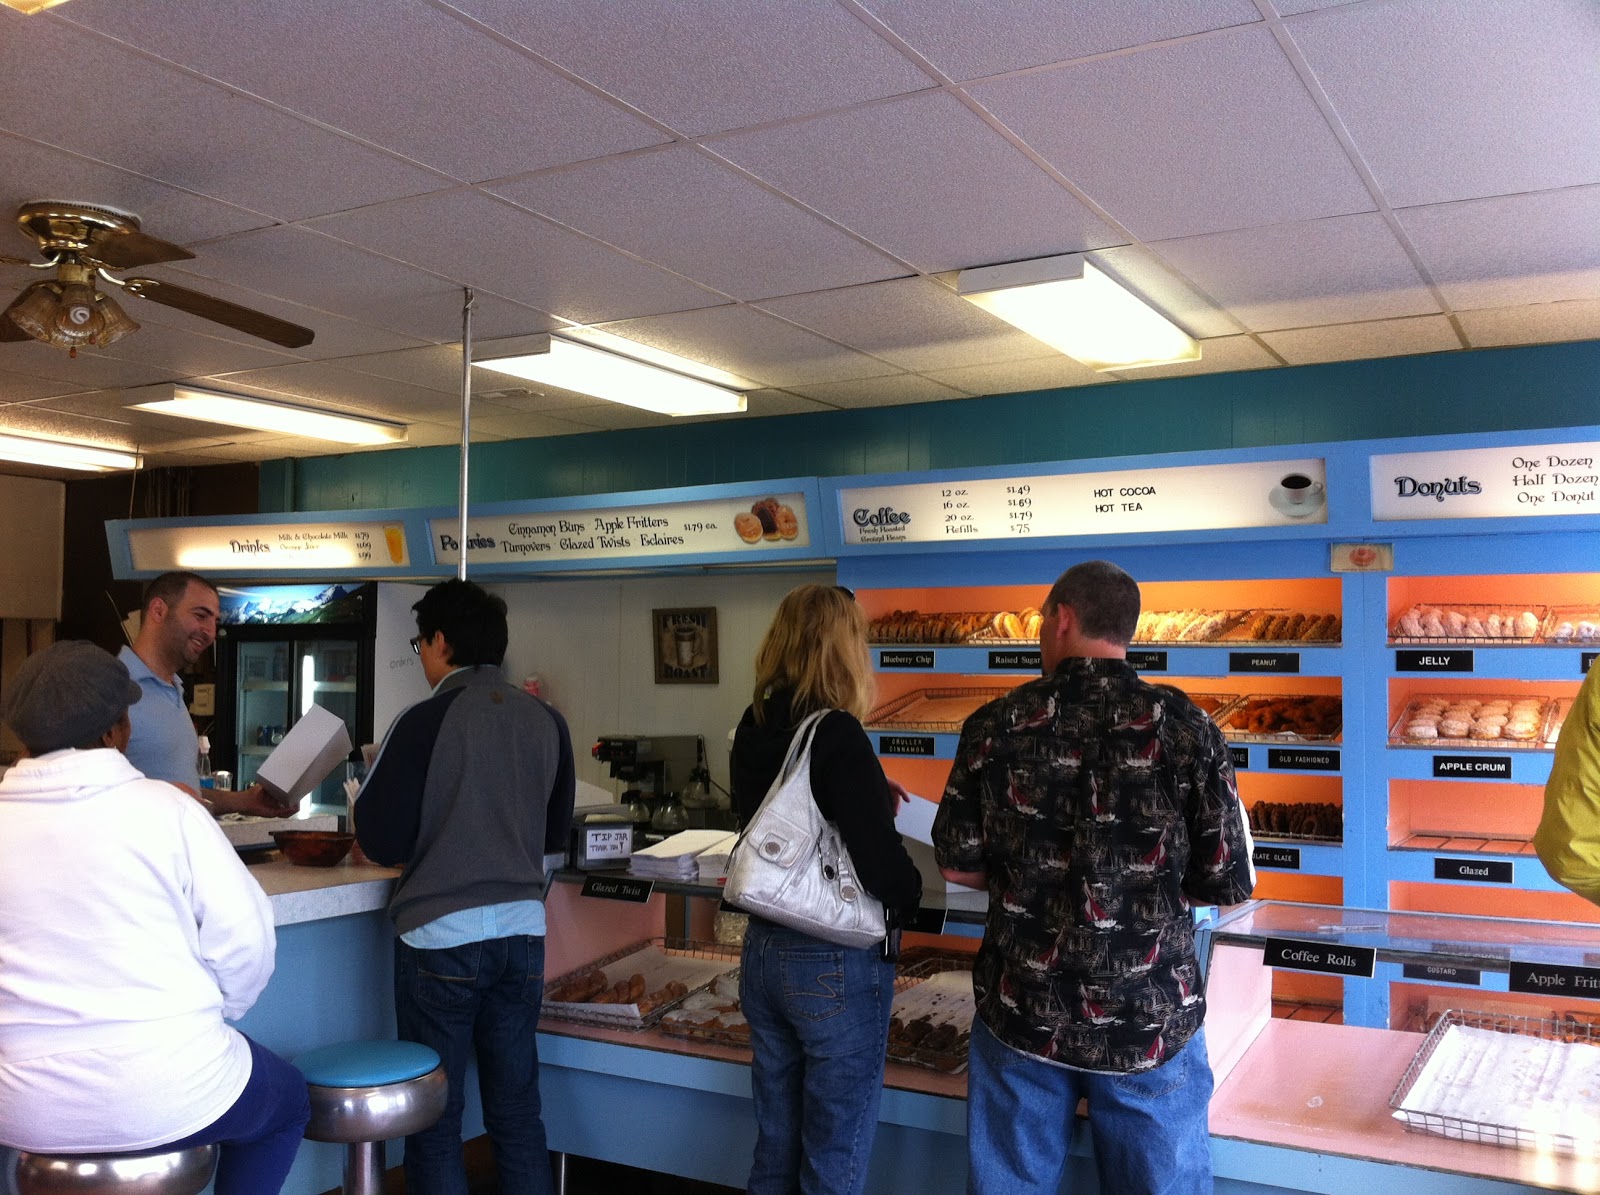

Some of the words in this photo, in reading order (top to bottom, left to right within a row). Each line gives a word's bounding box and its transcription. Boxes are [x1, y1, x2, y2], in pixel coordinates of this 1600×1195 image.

[1512, 456, 1541, 471] One
[1546, 455, 1593, 469] Dozen
[1512, 473, 1547, 486] Half
[1552, 472, 1599, 486] Dozen
[941, 489, 952, 497] 12
[1006, 485, 1031, 495] $1.49
[1094, 488, 1114, 498] HOT
[1119, 486, 1156, 497] COCOA
[1394, 475, 1483, 503] Donuts
[943, 501, 953, 509] 16
[1008, 498, 1032, 508] $1.69
[1517, 491, 1545, 506] One
[1551, 490, 1596, 505] Donut
[1095, 503, 1115, 513] HOT
[1121, 502, 1143, 513] TEA
[853, 506, 911, 527] Coffee
[945, 514, 957, 522] 20
[1009, 511, 1033, 521] $1.79
[508, 522, 556, 538] Cinnamon
[558, 519, 586, 535] Buns
[594, 517, 624, 534] Apple
[626, 515, 669, 528] Fritters
[683, 522, 703, 533] $1.79
[705, 522, 718, 530] ea.
[945, 524, 979, 534] Refills
[333, 531, 349, 540] Milk
[229, 538, 271, 556] Drinks
[440, 533, 496, 551] Patries
[500, 540, 551, 556] Turnovers
[559, 537, 595, 550] Glazed
[596, 536, 631, 548] Twists
[640, 533, 684, 547] Eclaires
[662, 612, 707, 628] FRESH
[883, 655, 913, 665] Blueberry
[915, 655, 932, 665] Chip
[995, 655, 1018, 664] Raised
[1021, 656, 1041, 665] Sugar
[1251, 658, 1277, 667] PEANUT
[1418, 656, 1451, 666] JELLY
[663, 662, 708, 679] ROAST
[889, 746, 925, 754] CINNAMON
[1279, 755, 1292, 763] OLD
[1295, 756, 1330, 764] FASHIONED
[1439, 762, 1473, 771] APPLE
[1475, 763, 1506, 772] CRUM
[591, 832, 612, 842] TIP
[614, 832, 628, 841] JAR
[1273, 853, 1293, 862] GLAZE
[1459, 865, 1489, 877] Glazed
[590, 881, 618, 894] Glazed
[620, 883, 642, 896] Twist
[1280, 947, 1320, 963] Coffee
[1327, 951, 1357, 968] Rolls
[1427, 966, 1457, 976] CUSTARD
[1527, 971, 1566, 987] Apple
